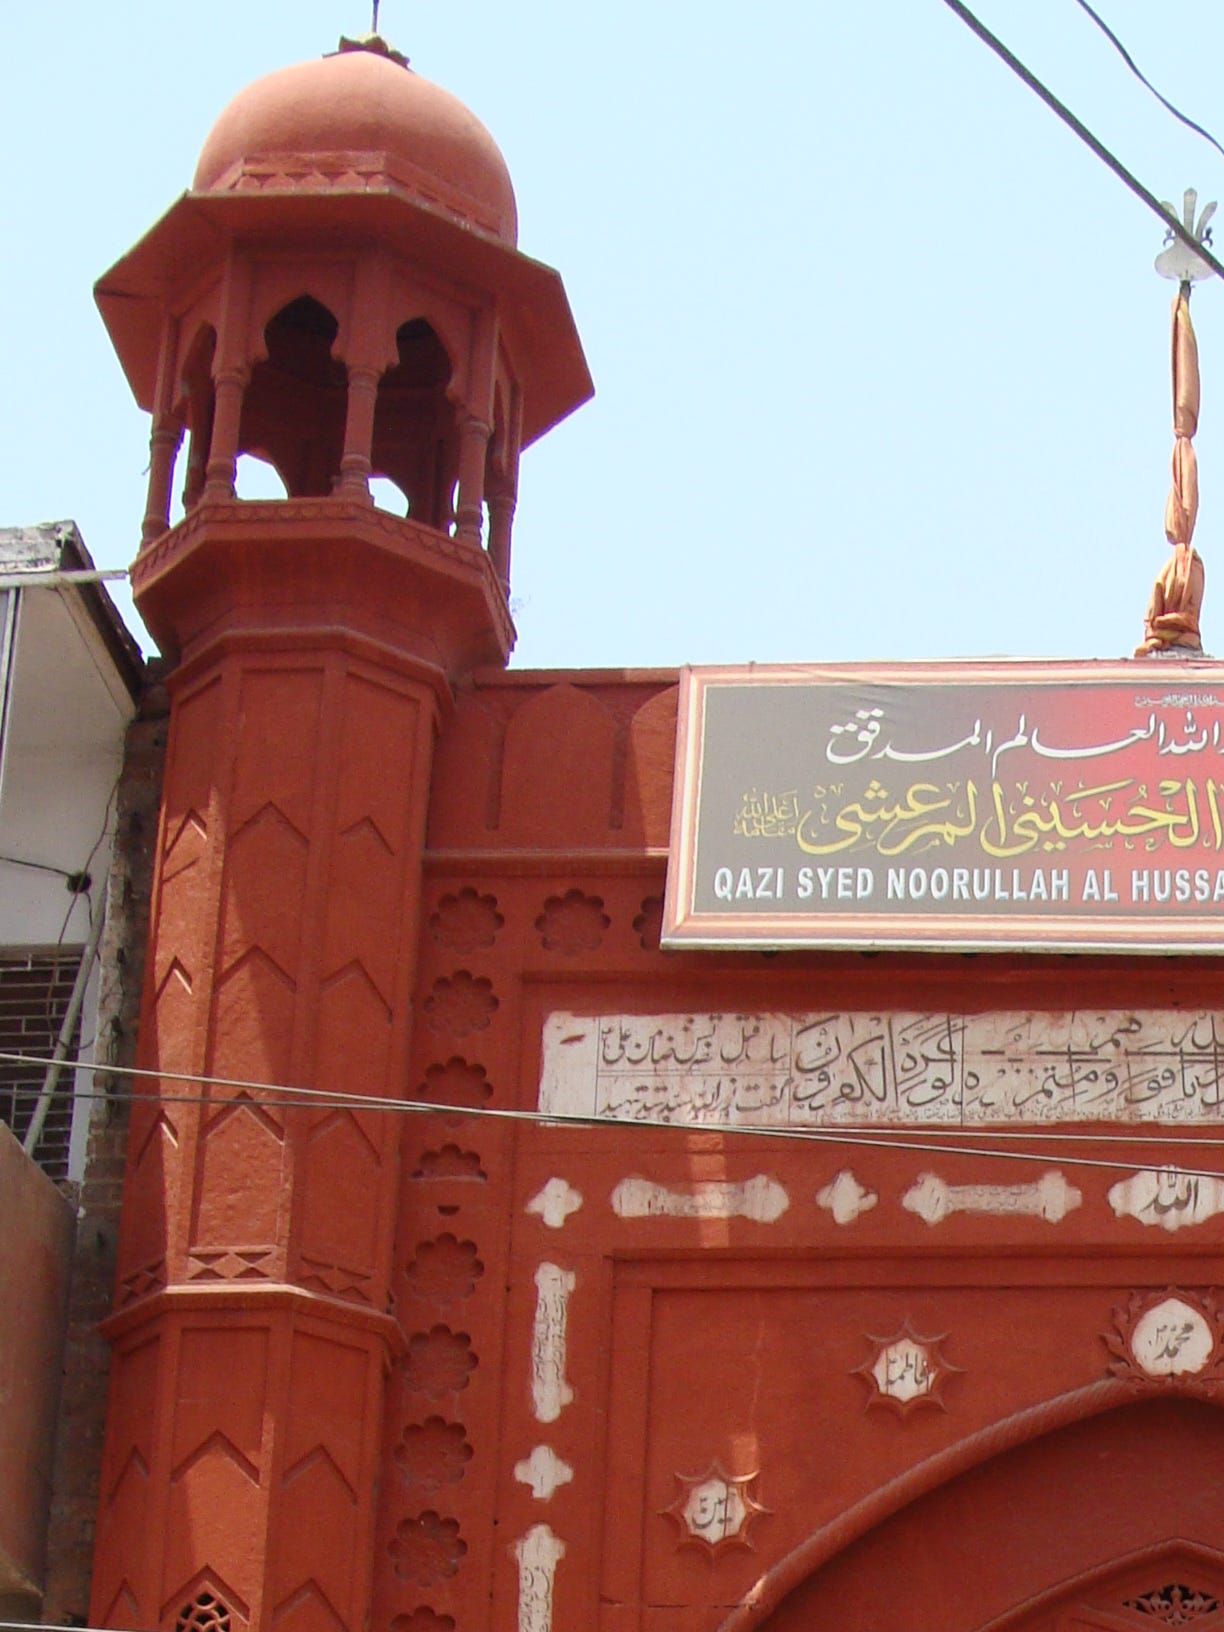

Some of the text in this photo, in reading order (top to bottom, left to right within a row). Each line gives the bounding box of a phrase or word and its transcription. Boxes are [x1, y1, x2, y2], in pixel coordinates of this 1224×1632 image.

[713, 867, 785, 902] QAZI
[798, 868, 874, 901] SYED
[887, 868, 1071, 902] NOORULLAH
[1082, 869, 1119, 902] AL
